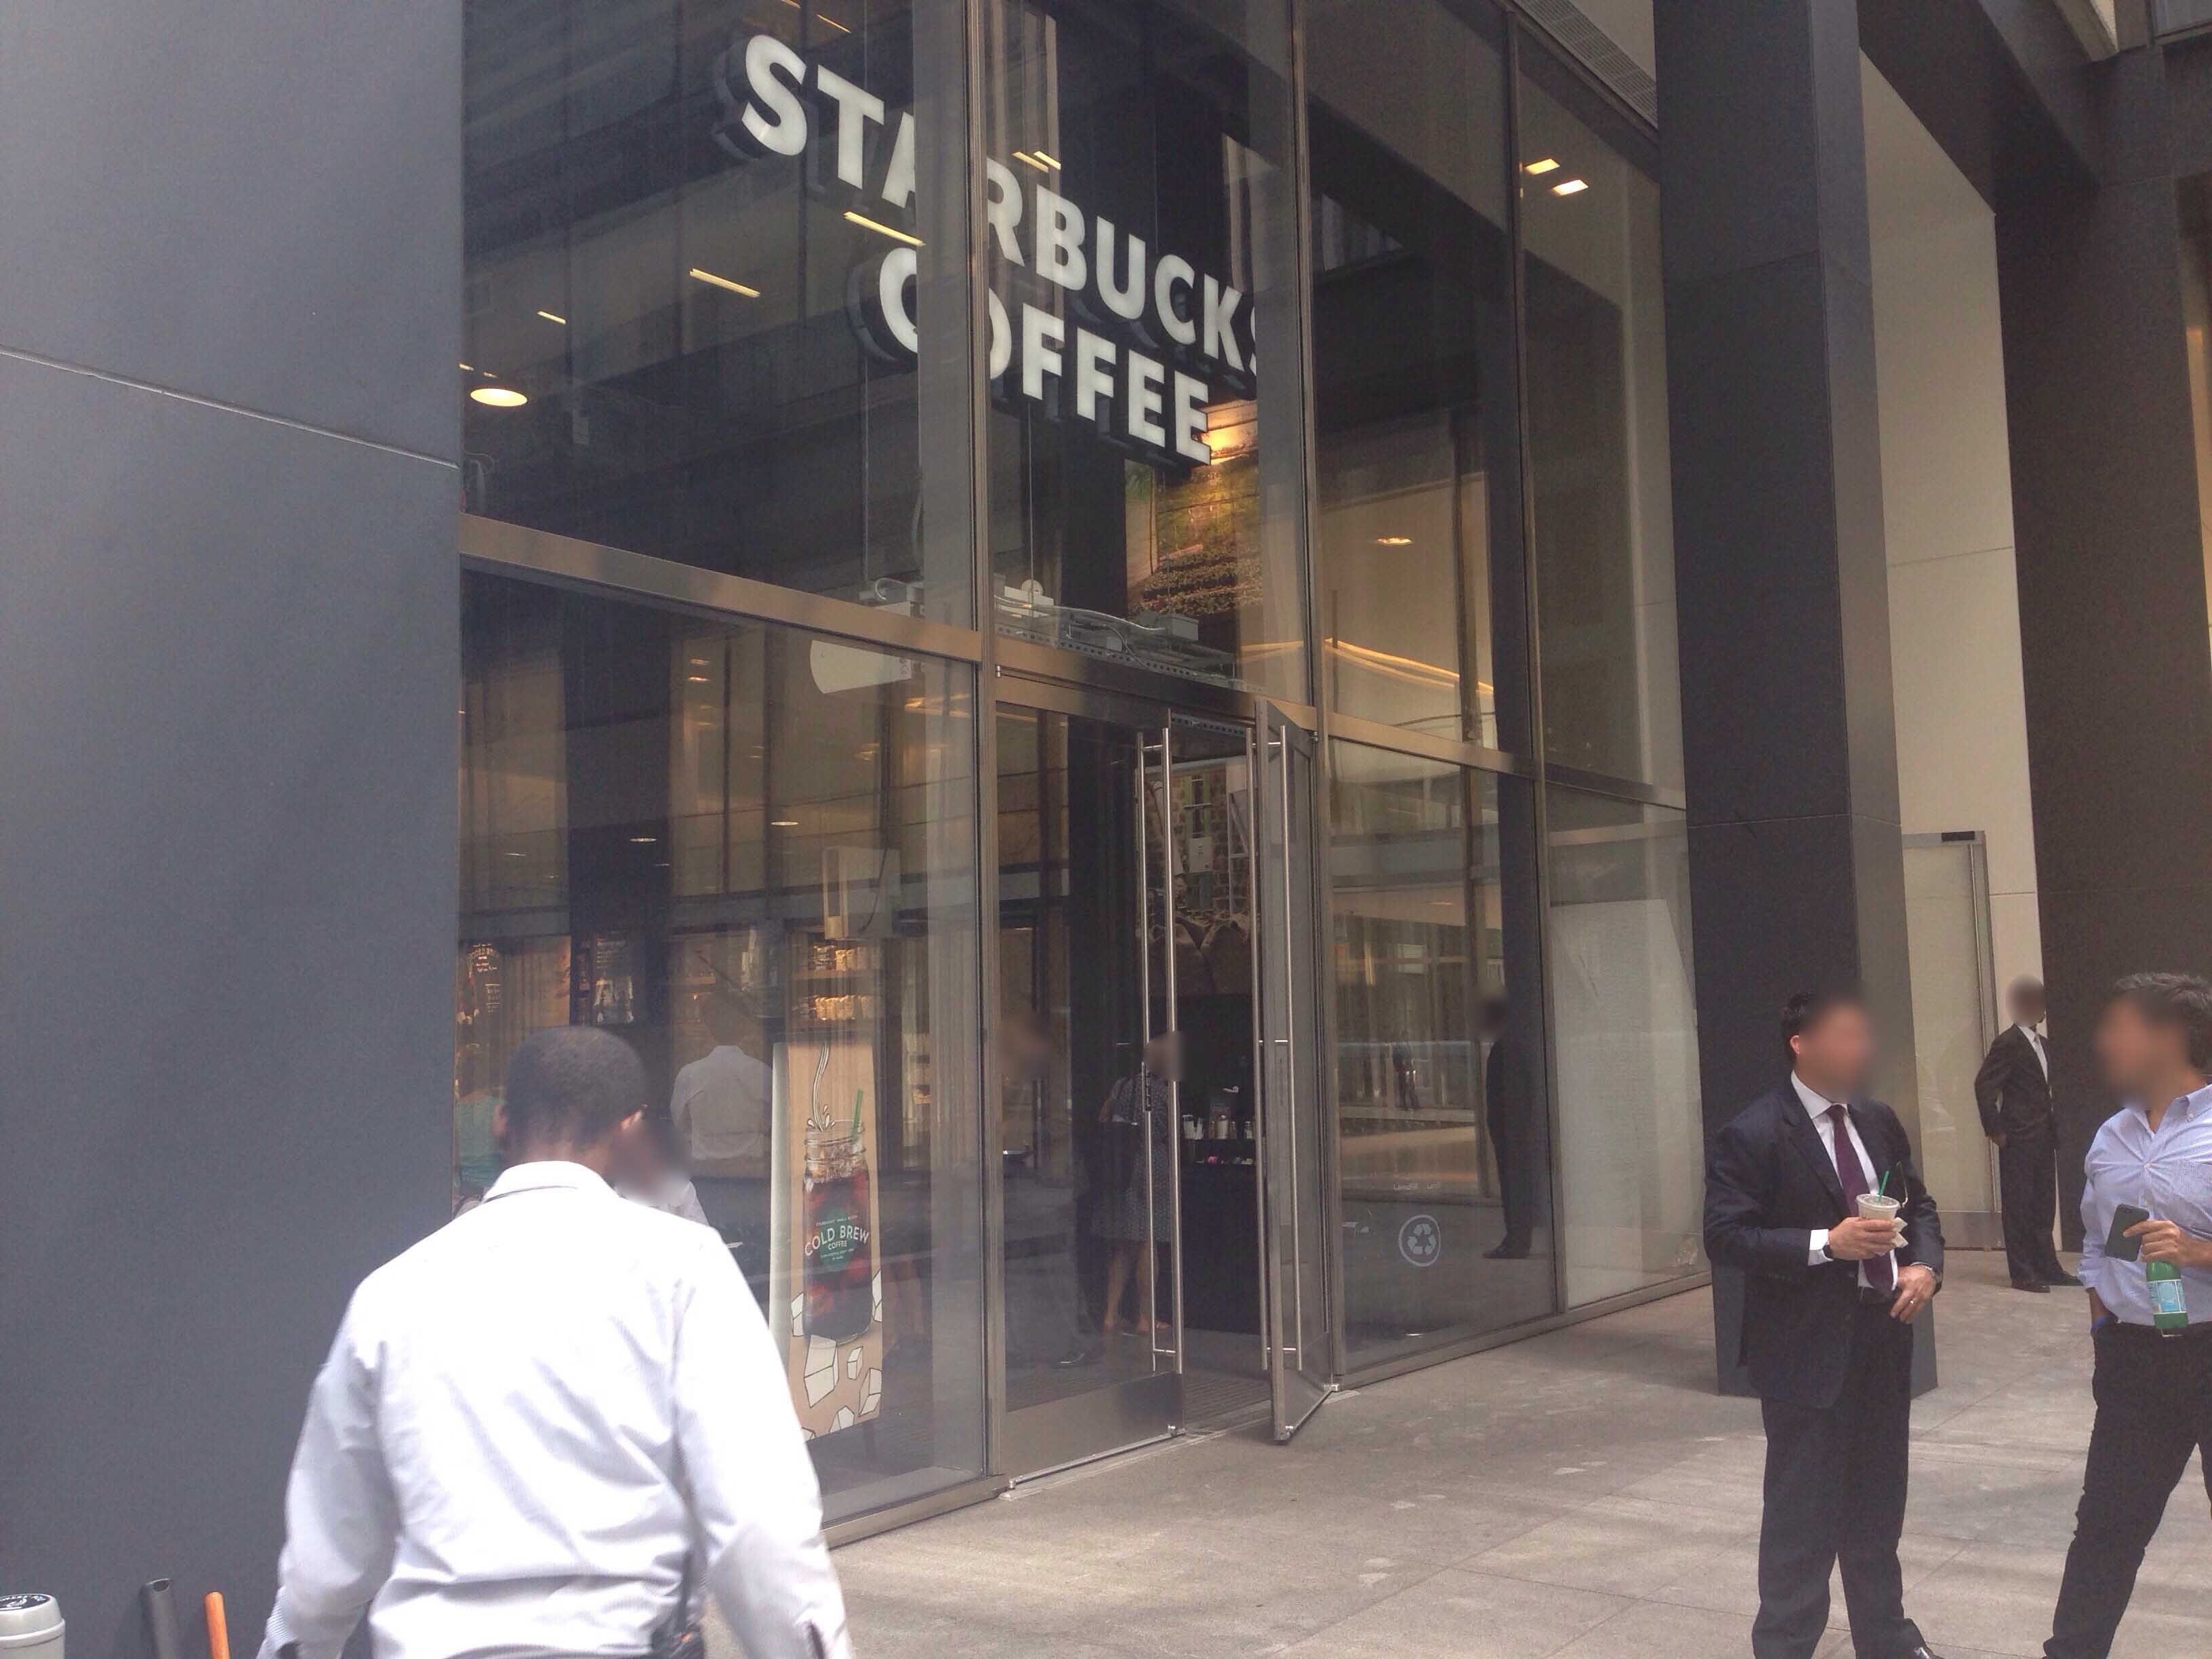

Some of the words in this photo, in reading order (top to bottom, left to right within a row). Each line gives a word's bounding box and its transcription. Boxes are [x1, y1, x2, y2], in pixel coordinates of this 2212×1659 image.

[742, 35, 1256, 377] STARBUCK
[804, 1227, 835, 1256] COLD
[840, 1225, 869, 1244] BREW
[828, 1240, 848, 1250] COFFEE
